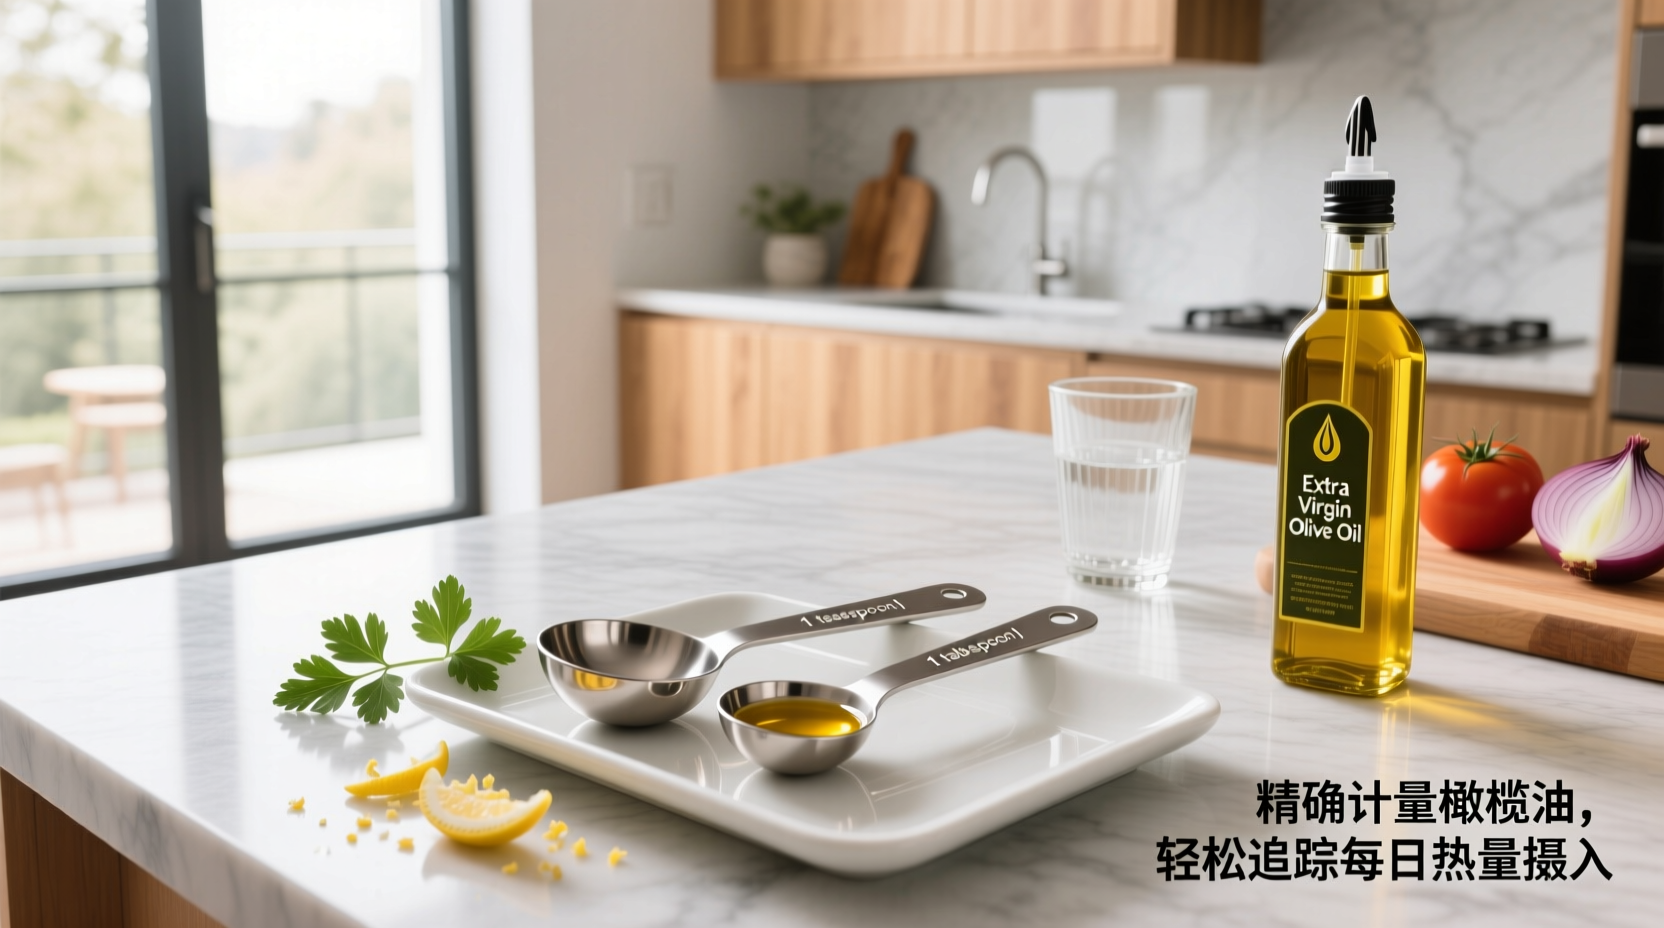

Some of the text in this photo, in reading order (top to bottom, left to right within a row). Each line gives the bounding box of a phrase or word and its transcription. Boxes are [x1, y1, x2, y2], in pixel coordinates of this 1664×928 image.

[1303, 474, 1350, 497] Extra
[1298, 495, 1351, 522] Virgin
[1289, 518, 1362, 543] Olive Oil
[800, 616, 813, 627] 1
[927, 655, 941, 667] 1
